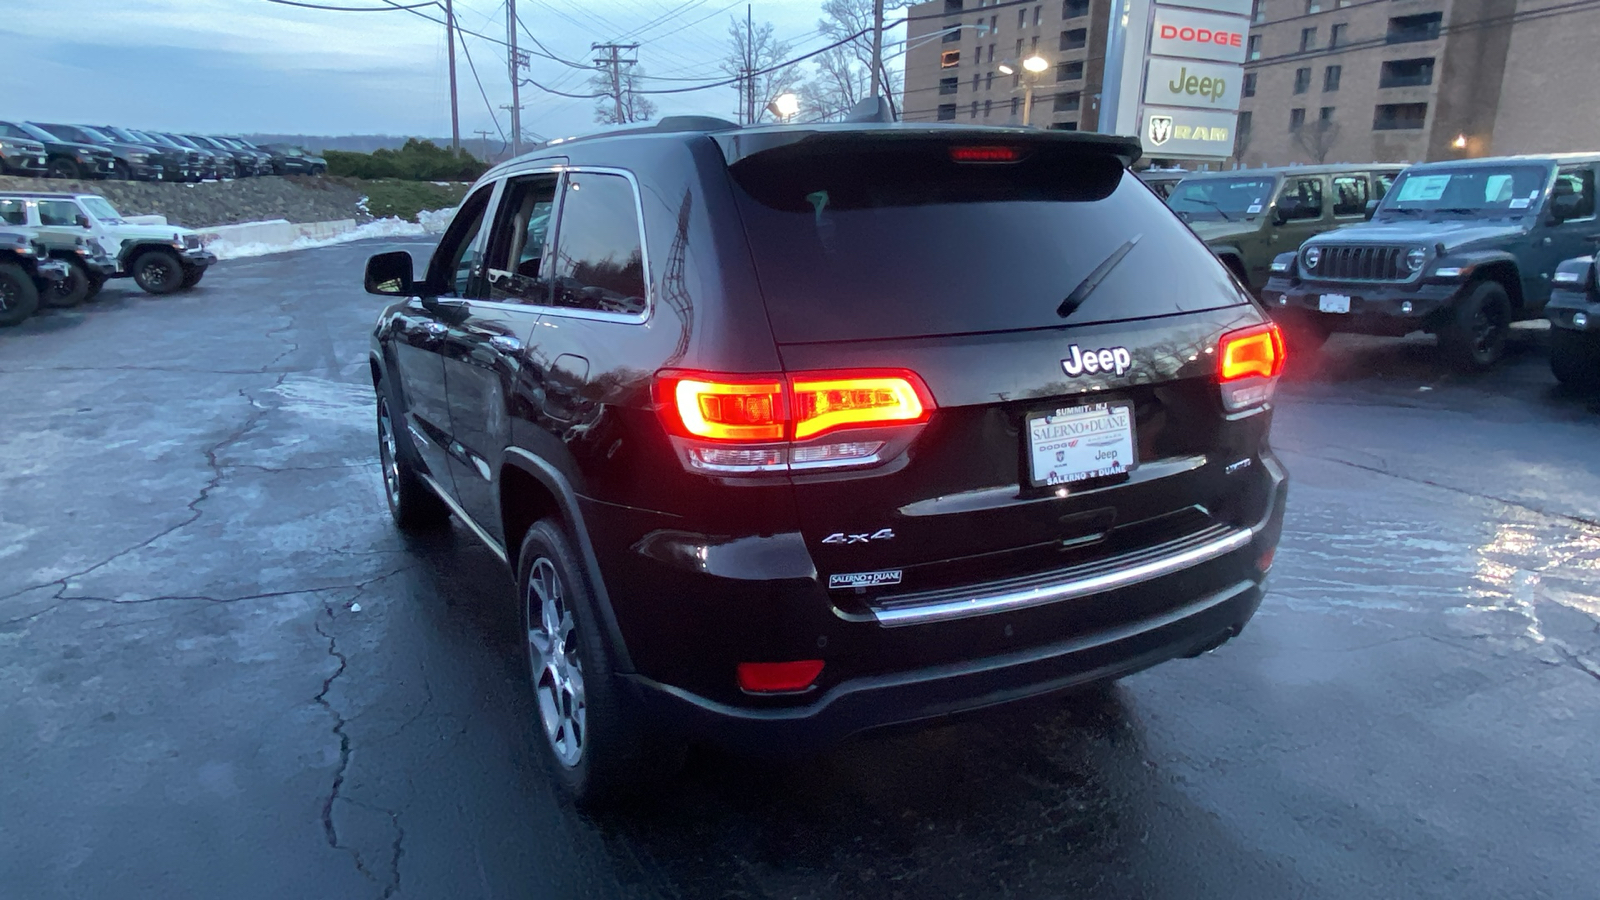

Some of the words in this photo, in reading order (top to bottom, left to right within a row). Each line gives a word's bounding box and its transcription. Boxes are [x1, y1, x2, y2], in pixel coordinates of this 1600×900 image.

[1160, 25, 1243, 47] DODGE
[1168, 67, 1226, 103] Jeep
[1174, 125, 1229, 142] RAM
[1061, 344, 1132, 378] Jeep
[1095, 402, 1108, 412] NJ
[1033, 423, 1084, 441] SALERNO
[1090, 415, 1127, 431] DUANE
[1095, 449, 1118, 461] Jeep
[1046, 471, 1087, 486] SALERNO
[1098, 465, 1127, 477] DUANE
[822, 528, 895, 545] 4x4
[832, 574, 867, 584] SALERNO
[873, 571, 900, 581] DUANE
